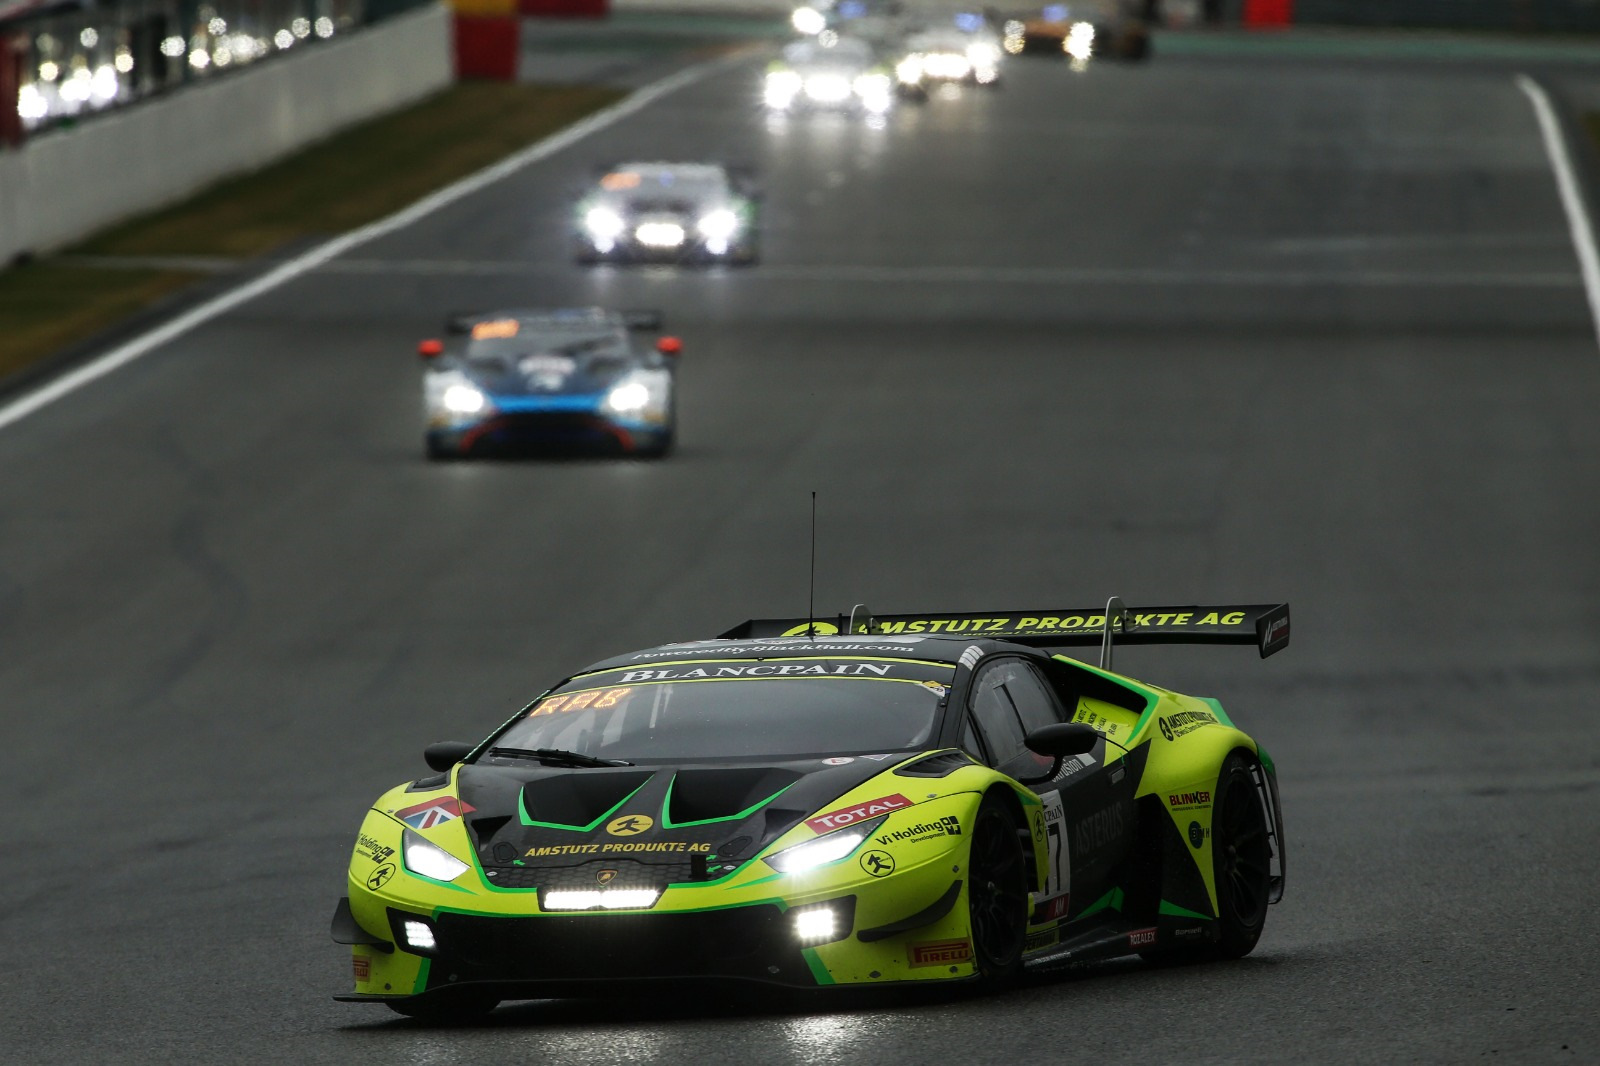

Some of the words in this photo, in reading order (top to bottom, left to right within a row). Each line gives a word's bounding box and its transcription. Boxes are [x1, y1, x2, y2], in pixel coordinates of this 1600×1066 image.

[1195, 612, 1246, 625] AG
[616, 663, 896, 683] BLANCPAIN
[1169, 791, 1210, 806] BLINKER
[814, 800, 904, 828] TOTAL
[1043, 804, 1063, 822] CPAIN
[876, 834, 893, 845] Vi
[892, 822, 945, 841] Holding
[1075, 801, 1124, 858] ASTERUS
[525, 844, 600, 857] AMSTUTZ
[602, 842, 686, 853] PRODUKTE
[688, 842, 712, 852] AG
[914, 942, 968, 963] PIRELLI
